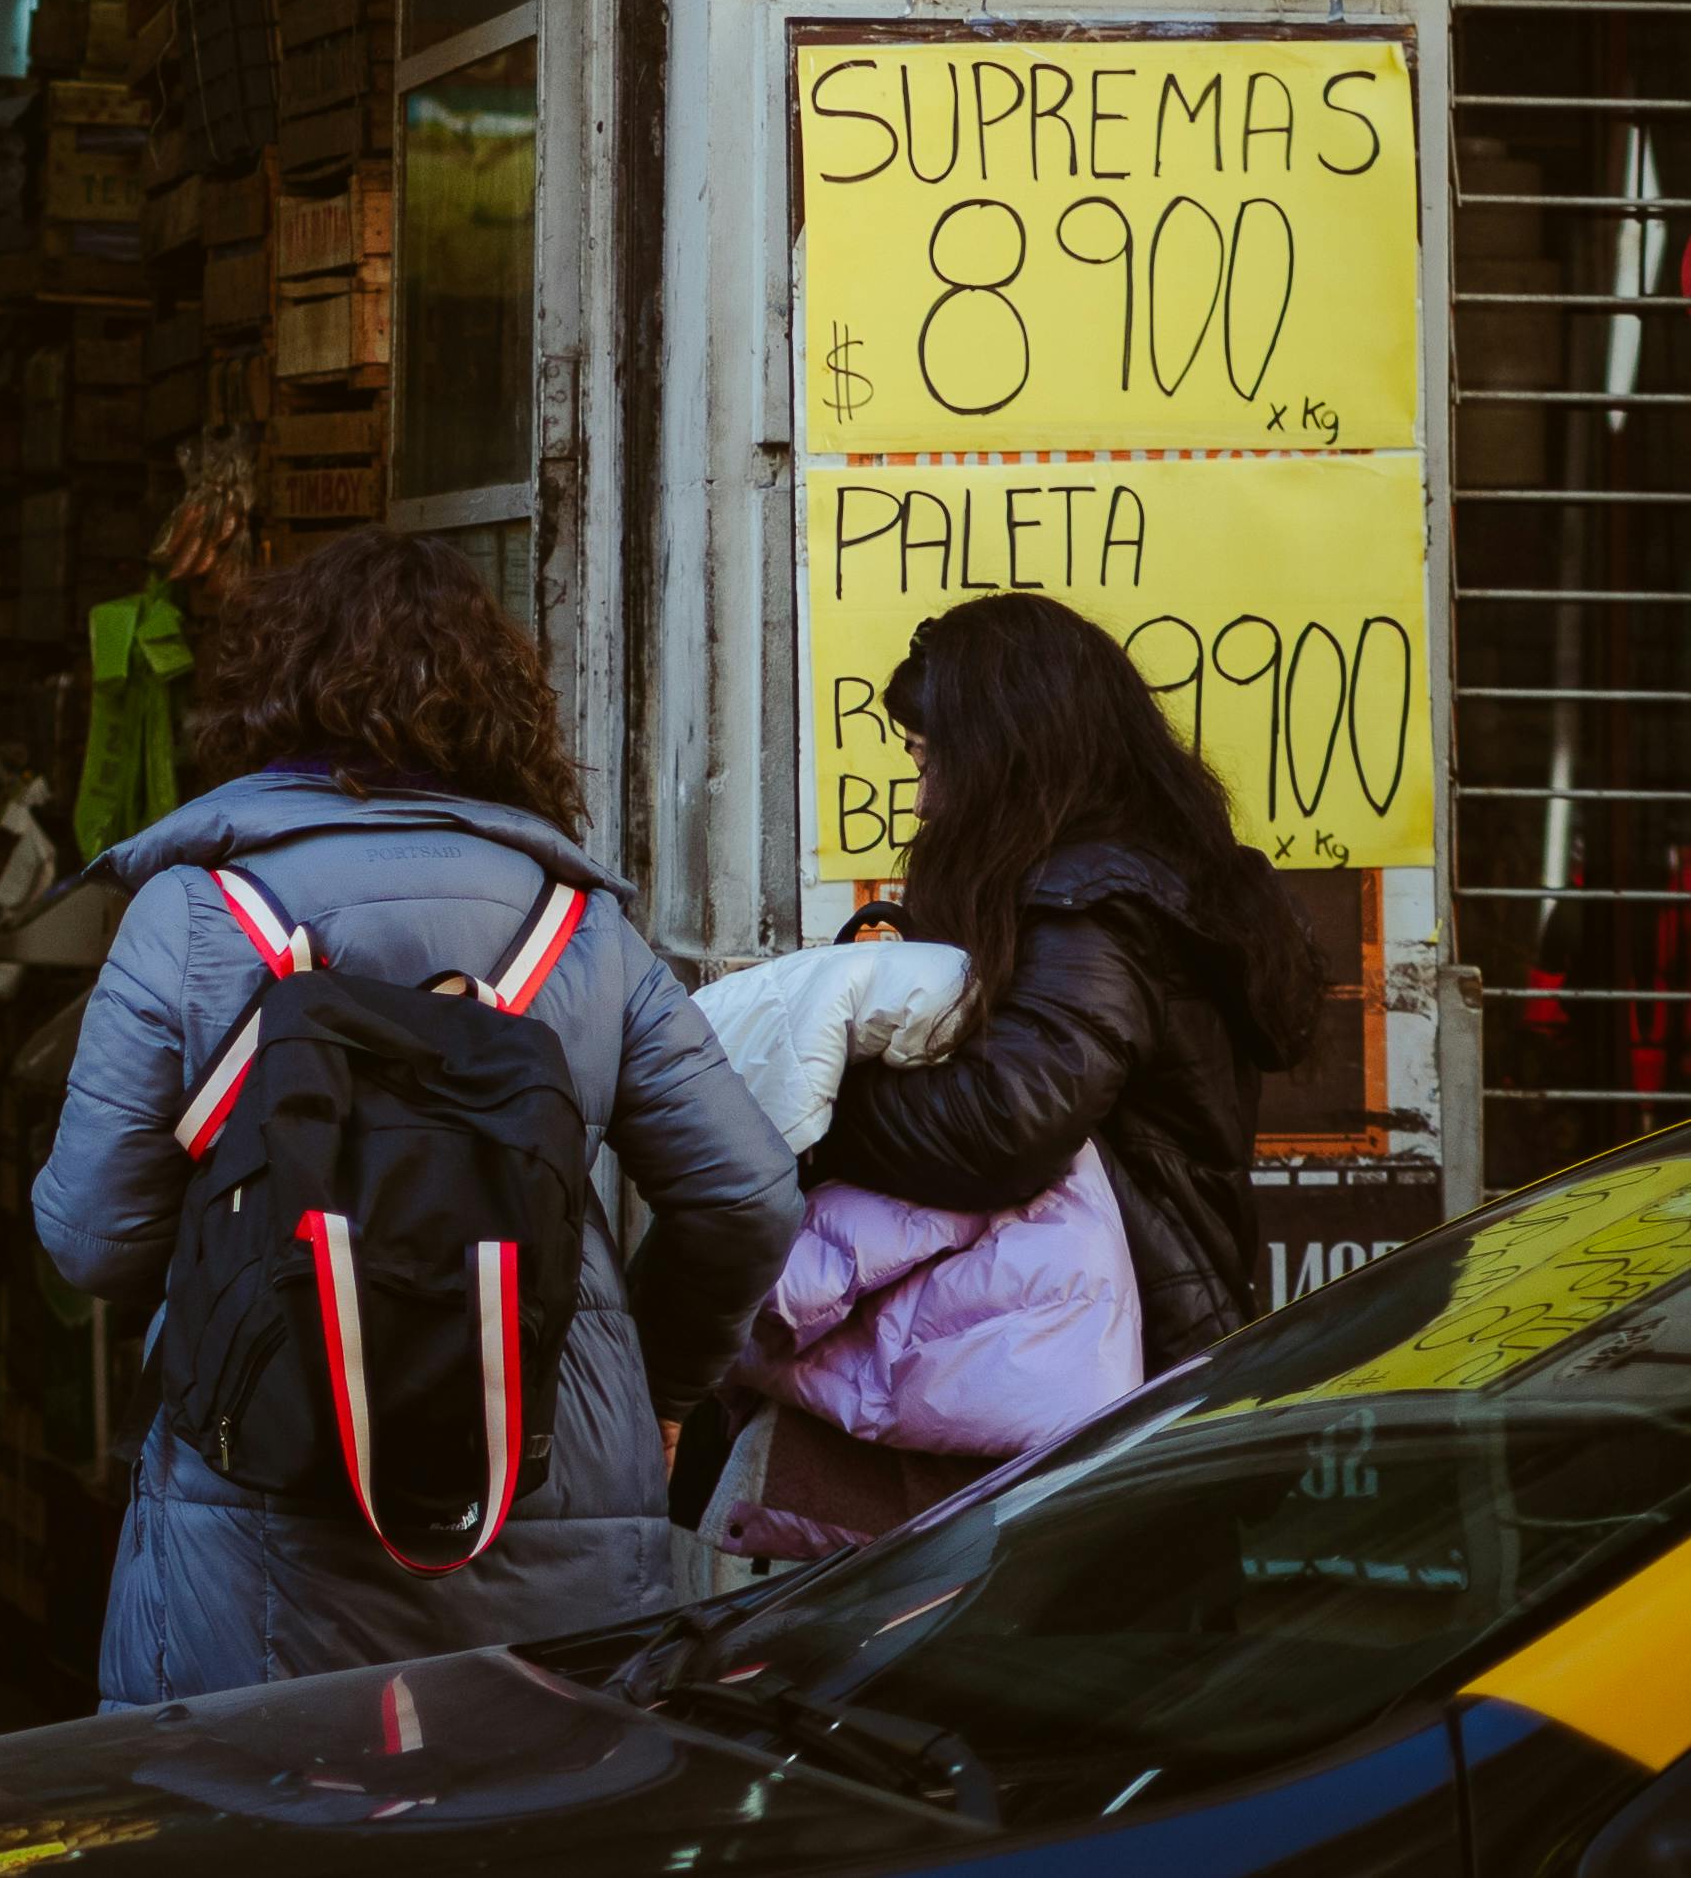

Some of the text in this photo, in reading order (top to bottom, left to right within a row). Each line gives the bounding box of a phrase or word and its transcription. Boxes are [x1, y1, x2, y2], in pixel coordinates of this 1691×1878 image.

[811, 58, 1381, 184] SUPREMAS
[917, 195, 1295, 417] 8900
[833, 484, 1146, 601] PALETA
[1123, 614, 1412, 823] 9900
